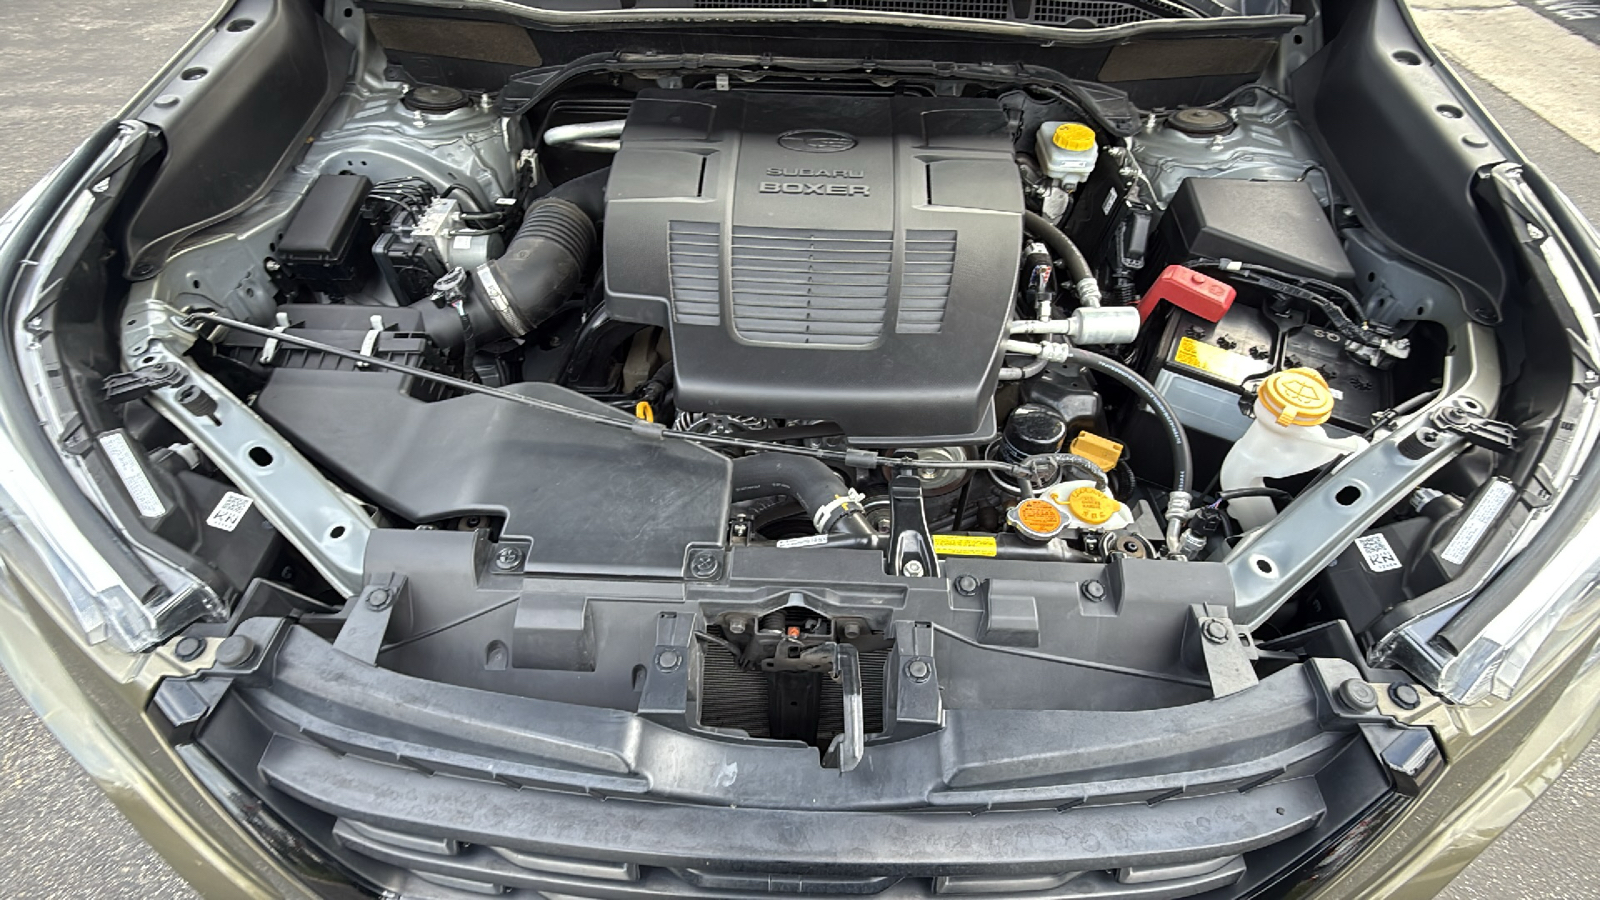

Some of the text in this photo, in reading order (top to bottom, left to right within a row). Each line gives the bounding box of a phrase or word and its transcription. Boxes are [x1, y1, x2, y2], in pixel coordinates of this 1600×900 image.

[766, 167, 864, 178] SUBARU
[759, 181, 870, 197] BOXER
[1369, 554, 1394, 566] KN
